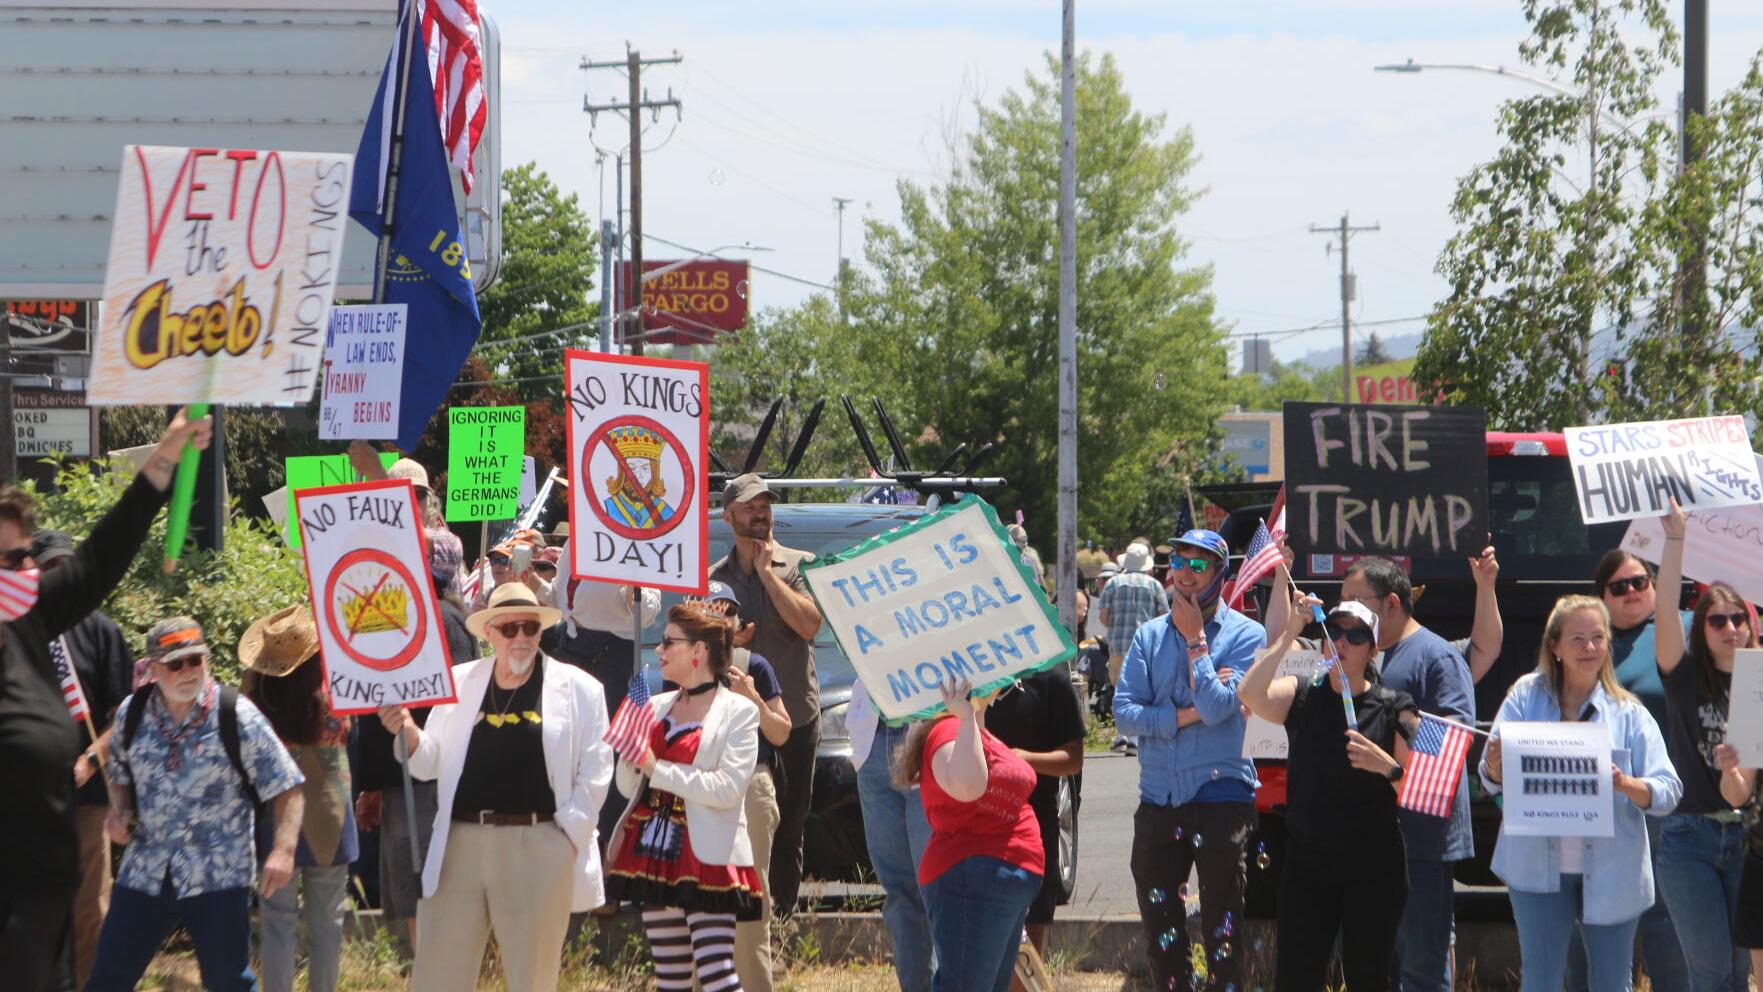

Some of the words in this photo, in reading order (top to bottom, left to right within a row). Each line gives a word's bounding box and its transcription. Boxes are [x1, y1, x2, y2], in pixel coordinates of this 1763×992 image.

[134, 145, 286, 273] VETO
[185, 221, 227, 275] the
[642, 270, 730, 291] WELLS
[119, 268, 284, 369] Cheeto!
[642, 293, 729, 314] FARGO
[326, 307, 355, 348] WHEN
[346, 341, 366, 363] LAW
[369, 341, 397, 365] ENDS,
[323, 360, 367, 400] TYRANNY
[566, 376, 606, 422] NO
[620, 372, 703, 418] KINGS
[18, 427, 35, 438] BQ
[353, 402, 392, 423] BEGINS
[452, 410, 521, 424] IGNORING
[480, 426, 496, 438] IT
[479, 440, 496, 453] IS
[1310, 407, 1431, 472] FIRE
[1578, 426, 1661, 457] STARS
[1667, 417, 1746, 448] STRIPES
[465, 455, 508, 468] WHAT
[473, 472, 501, 484] THE
[452, 487, 518, 502] GERMANS
[1578, 454, 1697, 519] HUMAN
[1688, 450, 1762, 501] RIGHTS
[302, 503, 336, 541] NO
[346, 496, 407, 529] FAUX
[1296, 484, 1473, 555] TRUMP
[593, 531, 684, 579] DAY!
[831, 558, 919, 608] THIS
[933, 533, 979, 571] IS
[854, 624, 884, 655] A
[894, 577, 1022, 639] MORAL
[886, 624, 1041, 702] MOMENT
[330, 671, 384, 705] KING
[393, 673, 446, 698] WAY!
[1560, 740, 1585, 748] STAND
